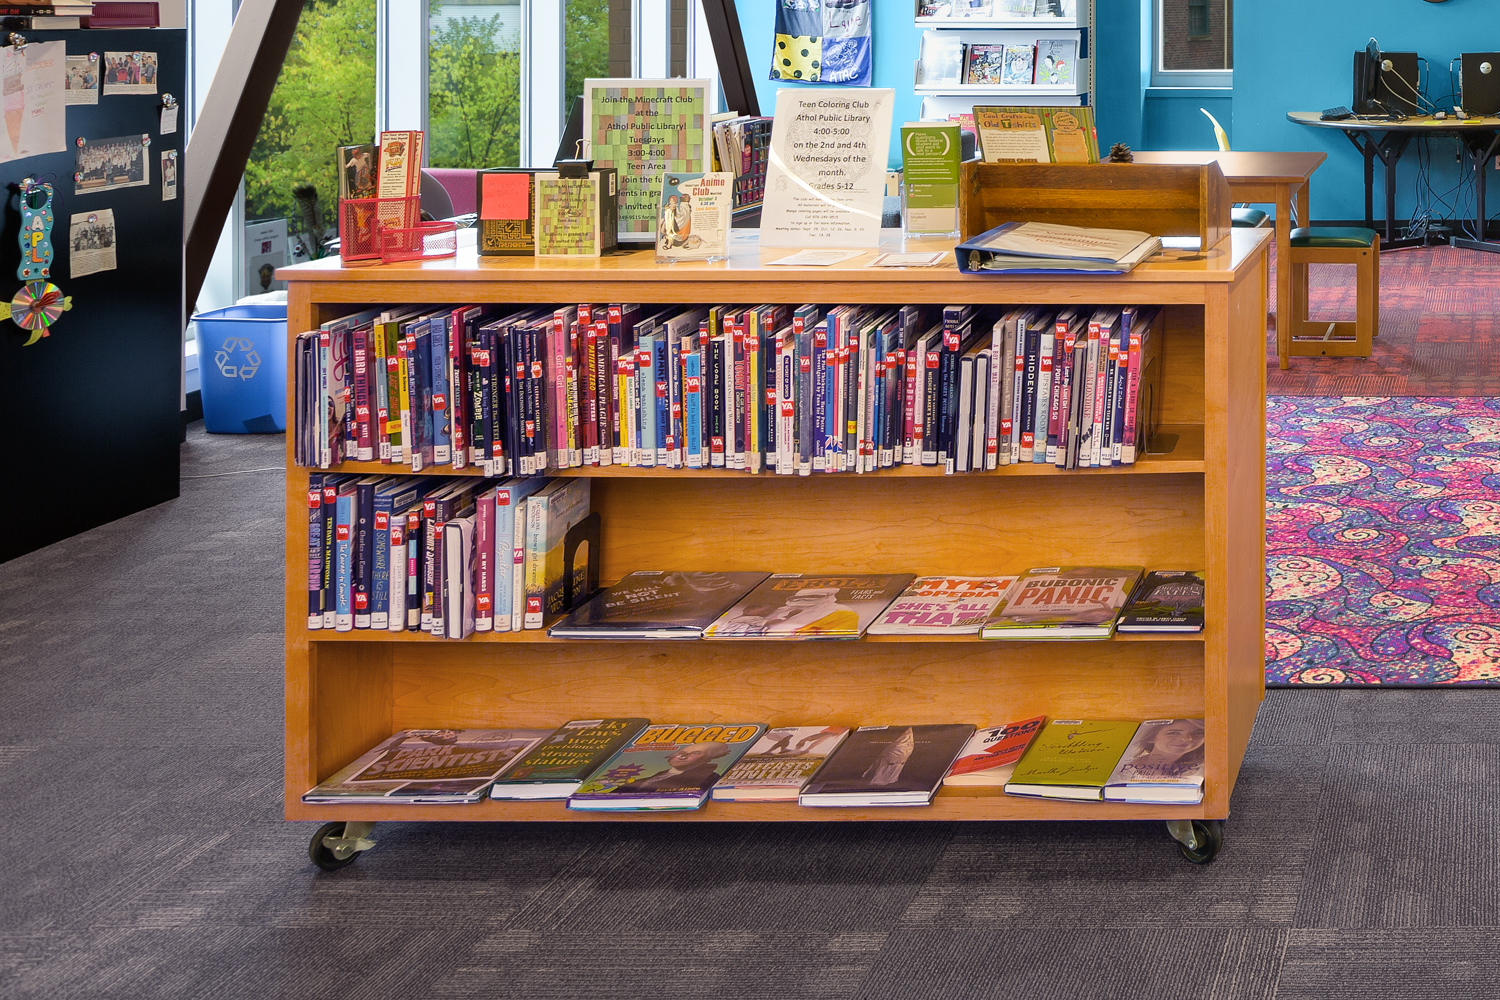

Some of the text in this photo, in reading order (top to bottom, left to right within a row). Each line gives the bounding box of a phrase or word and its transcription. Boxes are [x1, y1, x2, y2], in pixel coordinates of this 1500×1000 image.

[829, 69, 858, 82] ATAC
[818, 101, 850, 109] Coloring
[844, 115, 870, 123] Library
[629, 136, 665, 144] Tuesdays
[622, 176, 638, 184] Join
[693, 188, 710, 196] Club
[31, 215, 44, 263] APL
[355, 350, 367, 406] HARD THINGS
[556, 355, 565, 388] Girl Girl
[1027, 355, 1035, 393] HIDDEN
[597, 352, 608, 427] AMERICAN PLAGUE
[1084, 377, 1094, 419] KLONDIKE
[1039, 373, 1049, 433] UPSTAIRS ROOM
[309, 523, 321, 591] GREAT BARNUM
[497, 539, 511, 579] Popular
[1024, 578, 1127, 588] BUBONIC
[625, 590, 658, 599] NOT
[630, 592, 680, 603] SILENT
[1012, 586, 1115, 608] PANIC
[949, 603, 989, 611] ALL
[642, 725, 766, 745] BUGGED
[982, 728, 1042, 745] QUESTIONS
[986, 719, 1042, 738] 100
[370, 747, 518, 773] SCIENTISTS
[393, 746, 454, 760] PARK
[730, 769, 802, 780] UNITED
